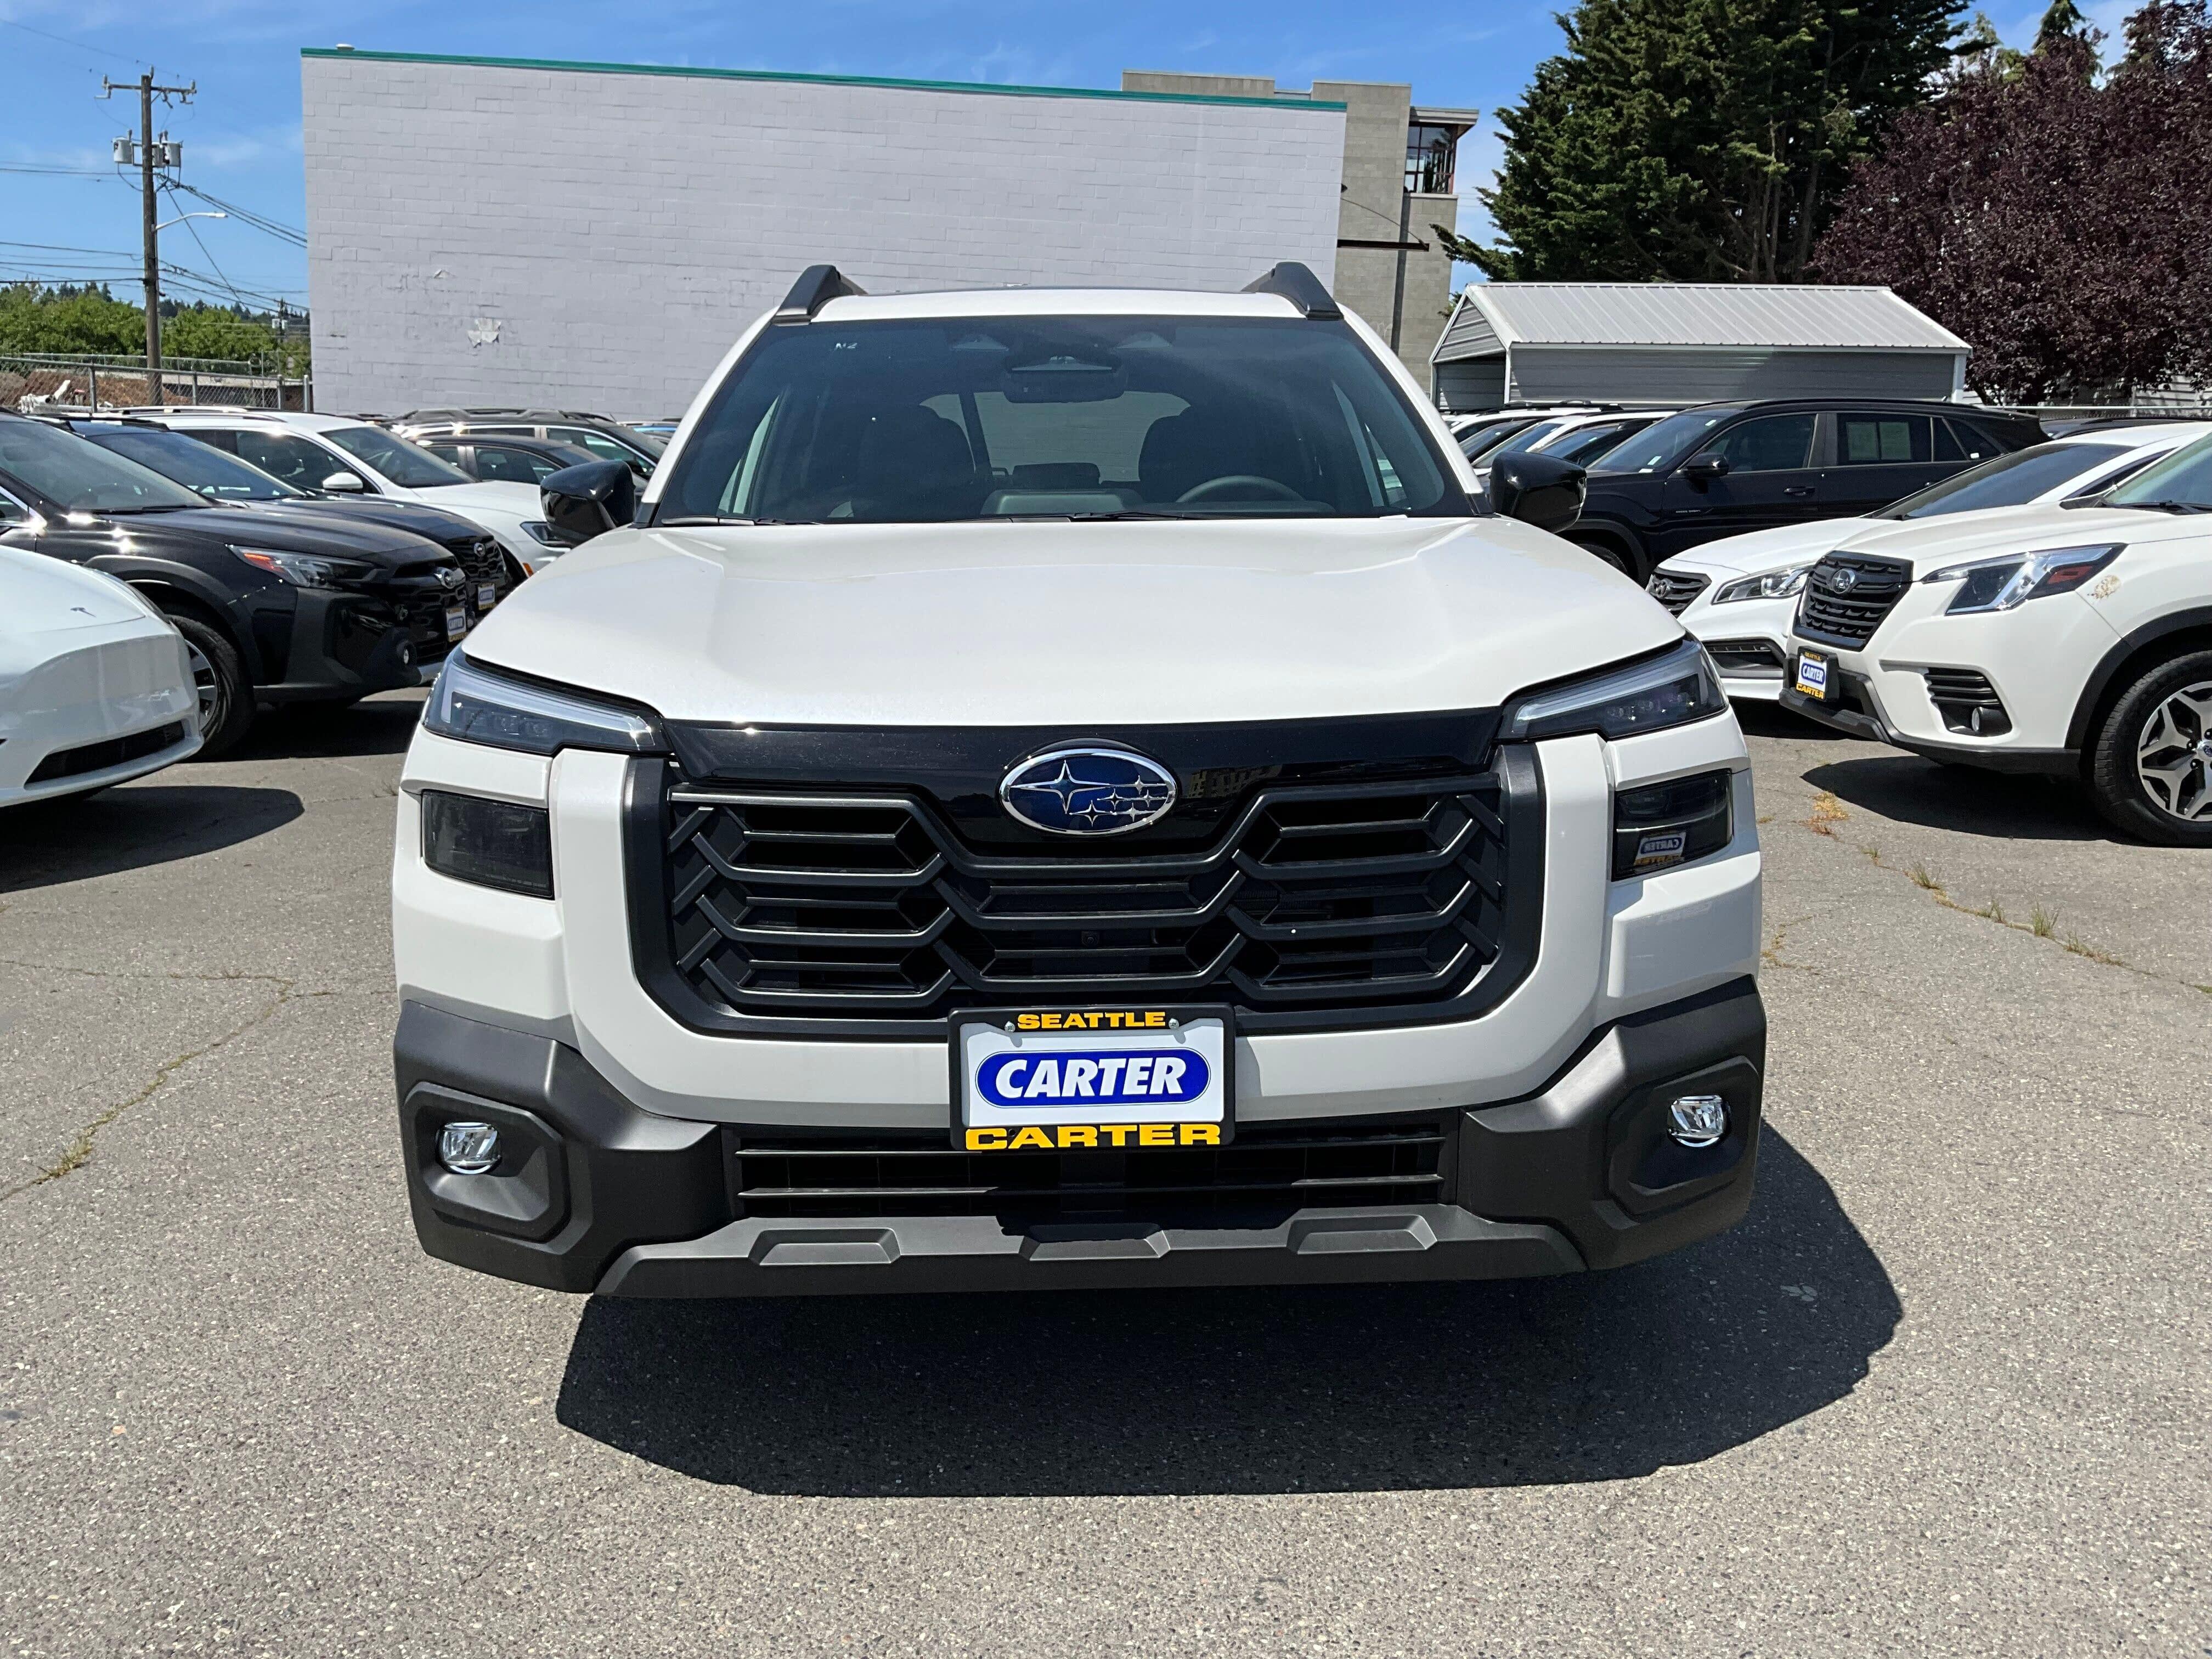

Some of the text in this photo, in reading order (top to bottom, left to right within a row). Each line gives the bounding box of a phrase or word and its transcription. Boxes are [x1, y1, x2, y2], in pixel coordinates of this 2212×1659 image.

[1803, 665, 1824, 682] CARTER
[1796, 683, 1824, 699] CARTER
[1017, 1012, 1166, 1030] SEATTLE
[996, 1057, 1186, 1098] CARTER
[965, 1124, 1220, 1150] CARTER
